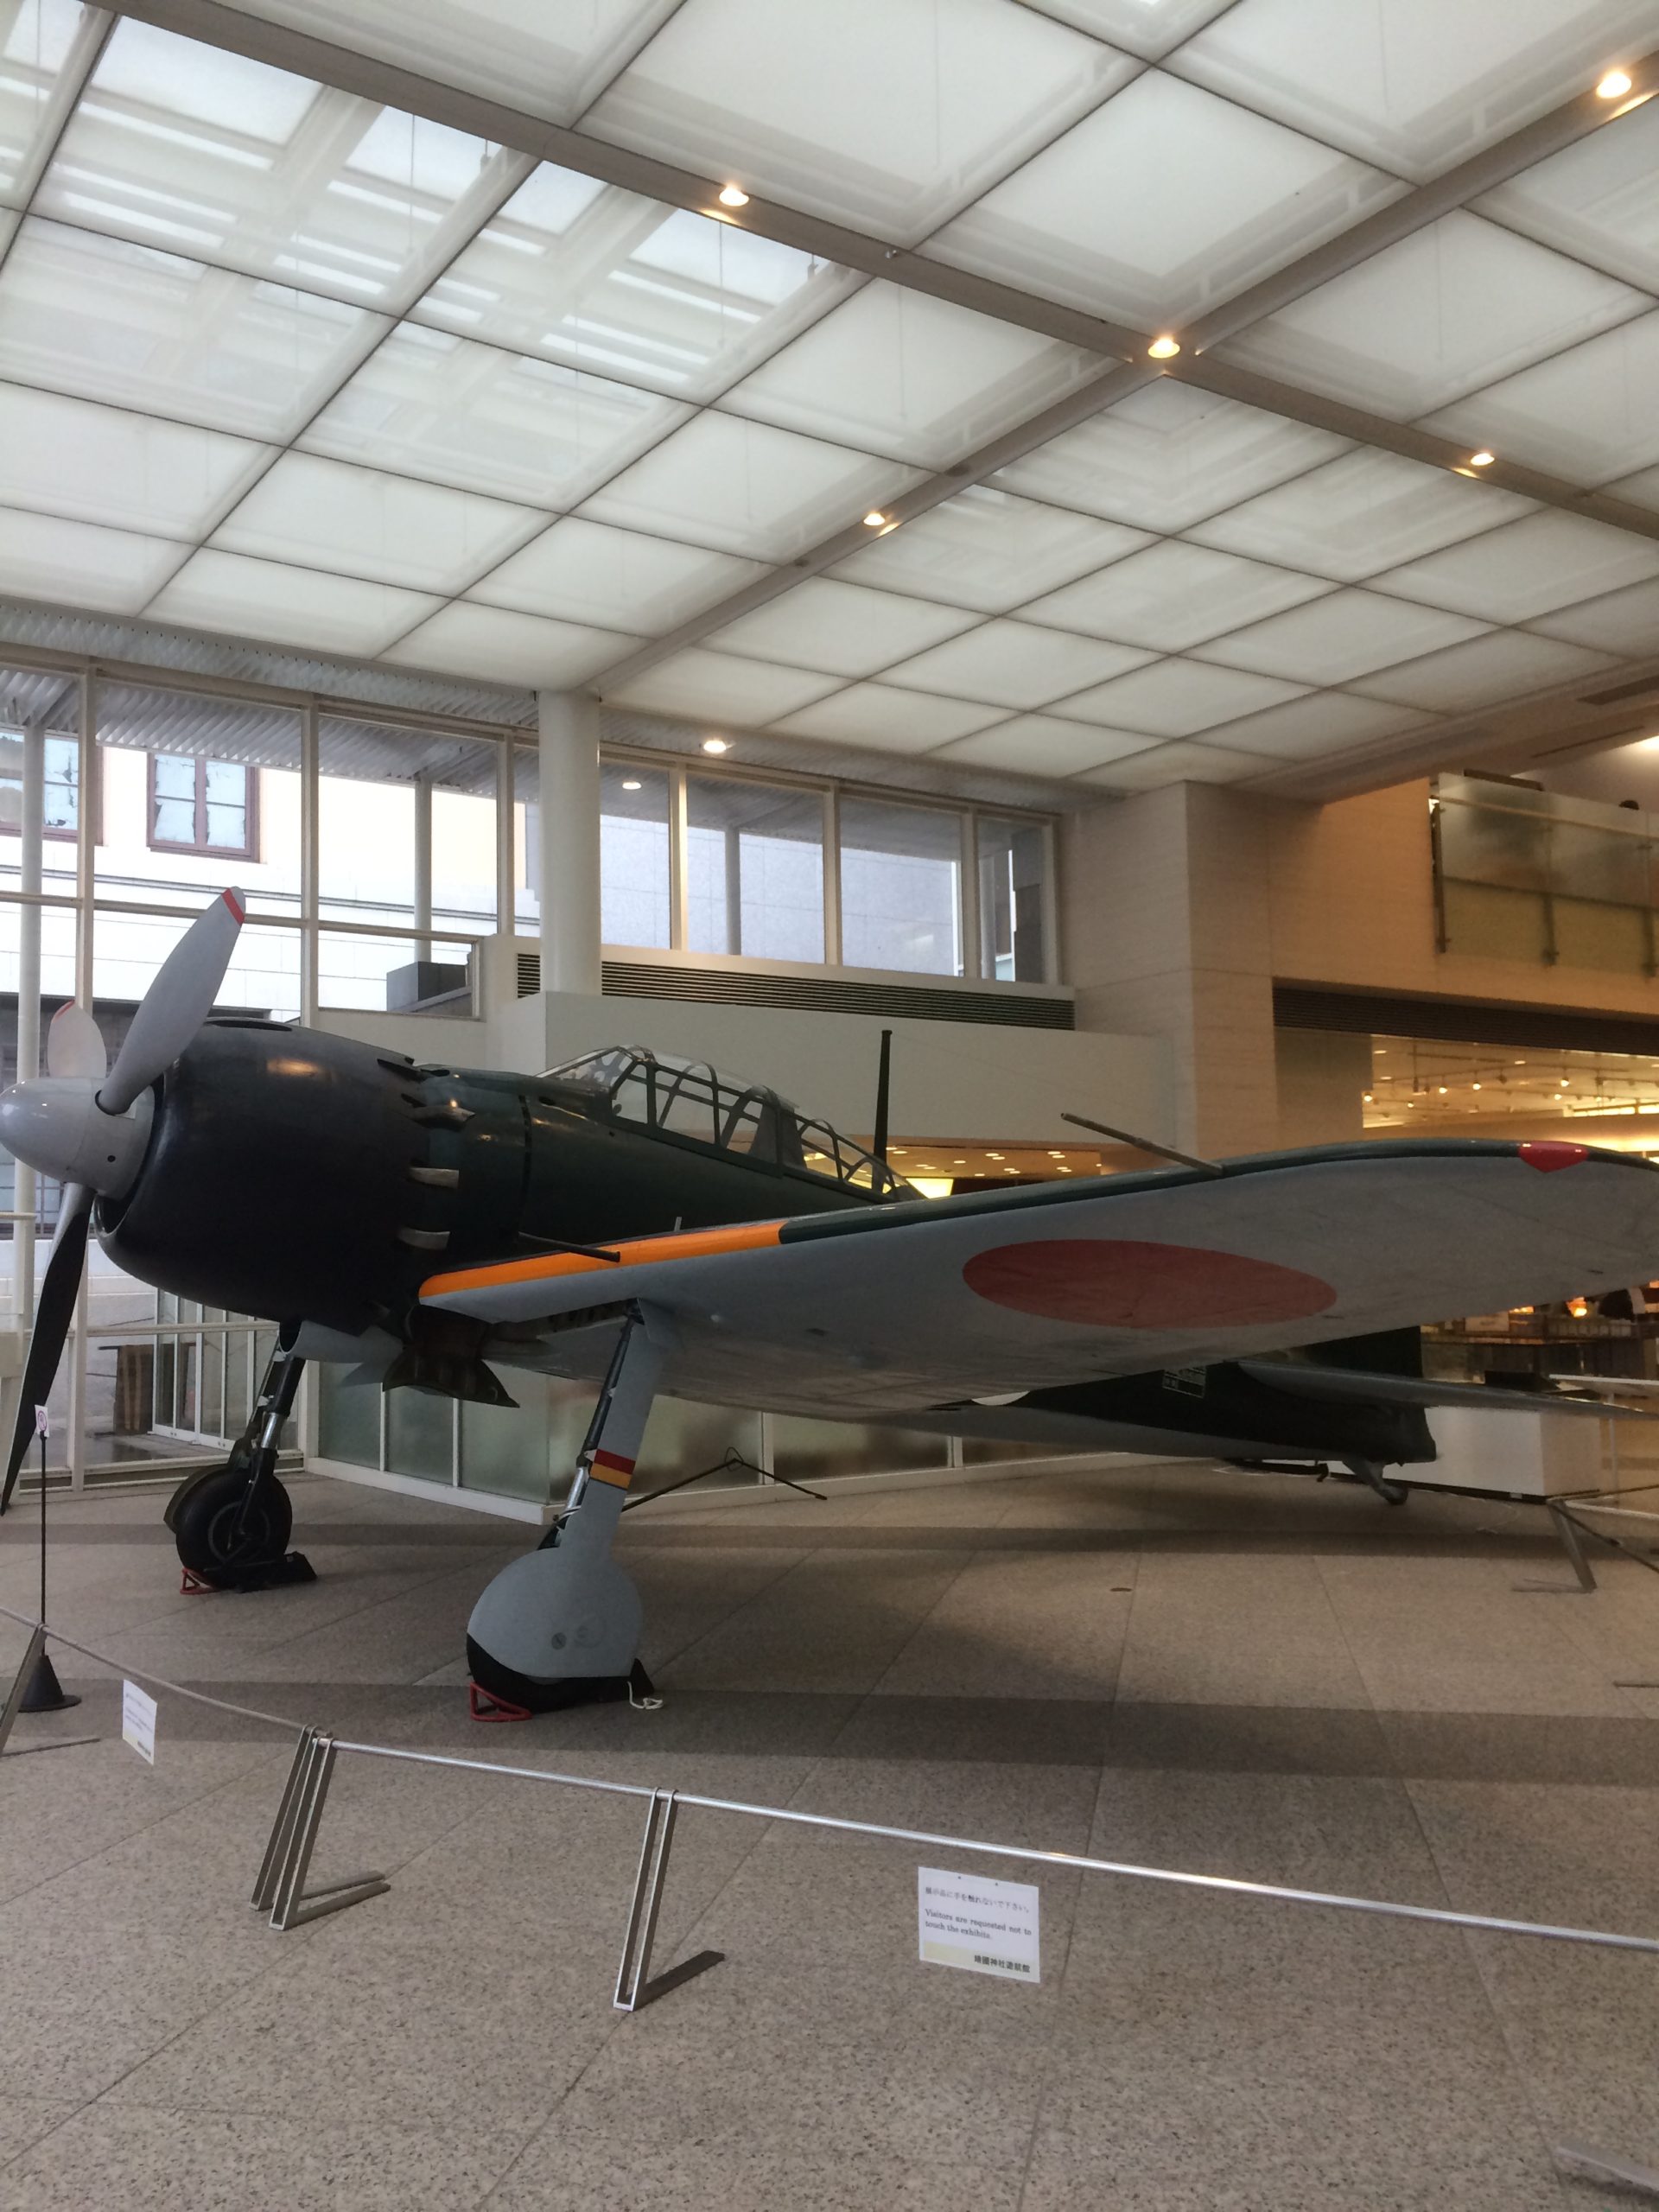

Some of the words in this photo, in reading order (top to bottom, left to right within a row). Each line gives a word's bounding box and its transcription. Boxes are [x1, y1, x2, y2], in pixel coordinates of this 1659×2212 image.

[925, 1908, 953, 1921] Visitors
[970, 1918, 1007, 1931] requested
[1009, 1926, 1021, 1935] not
[925, 1920, 945, 1930] touch
[947, 1923, 959, 1934] the
